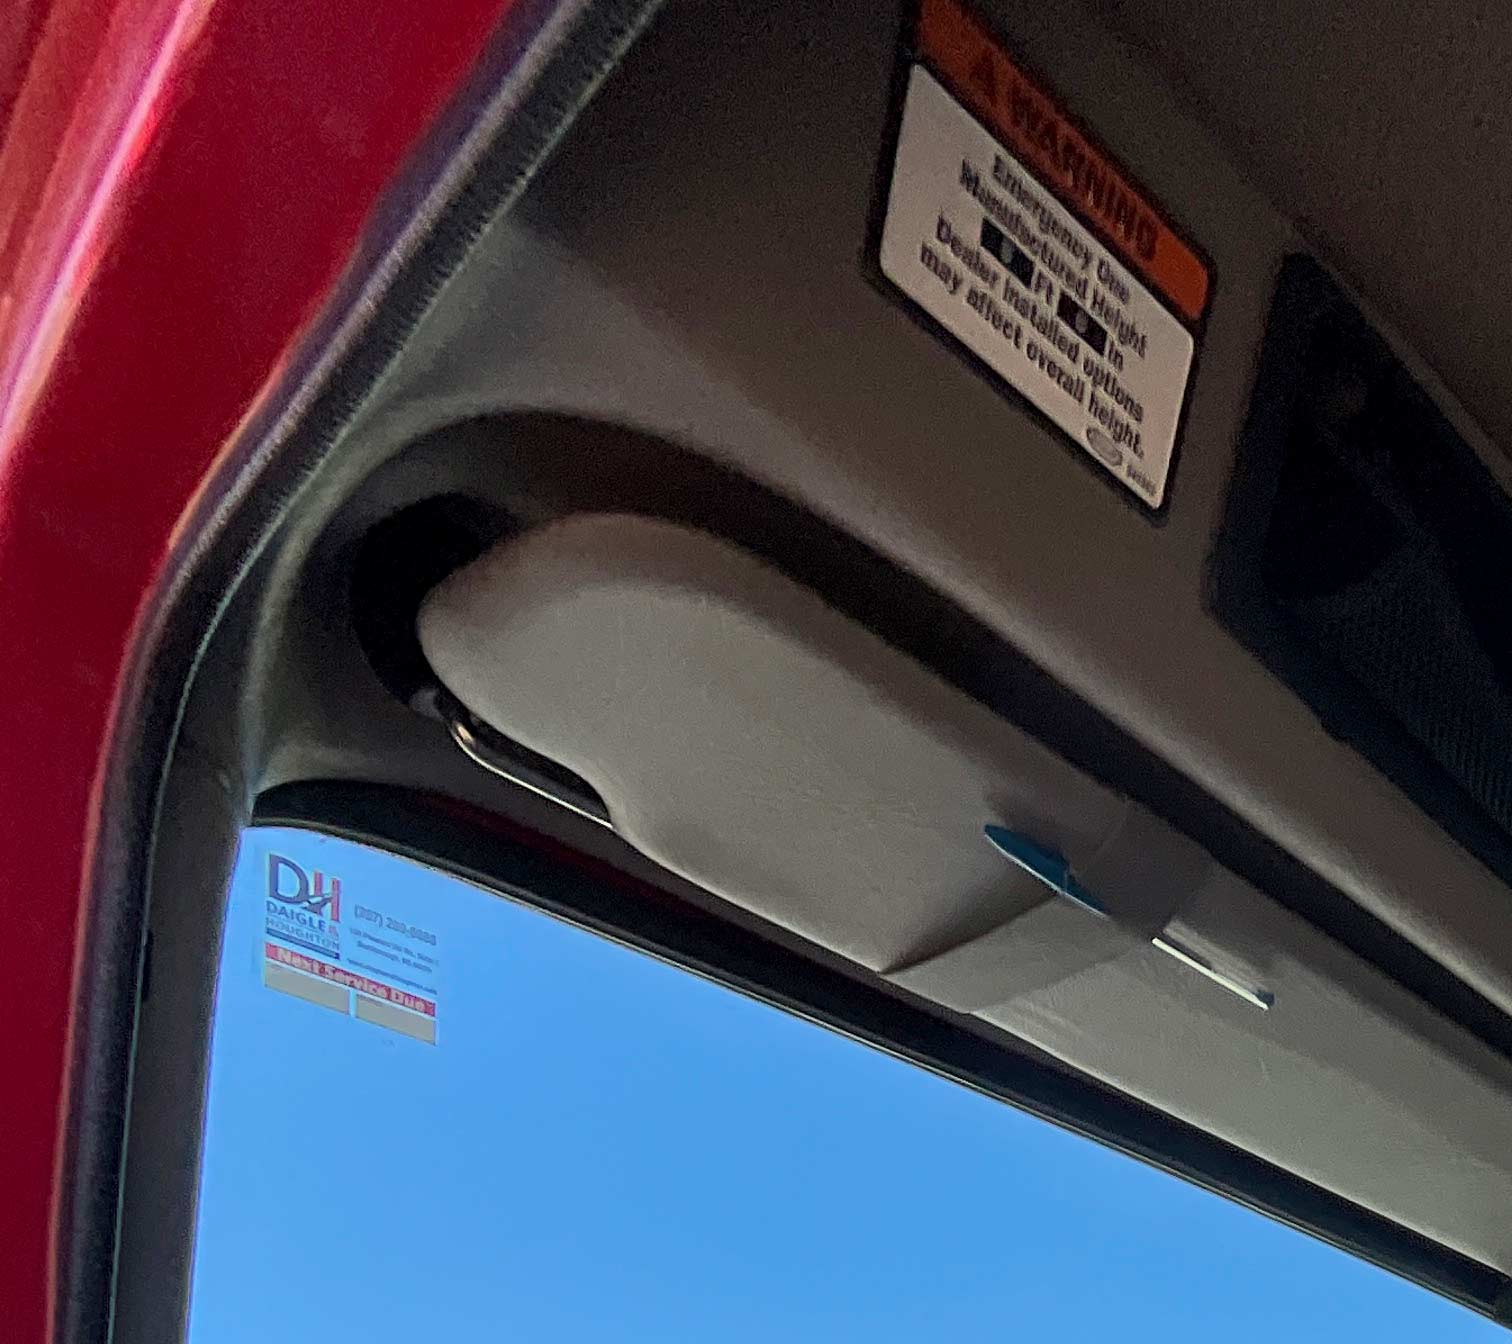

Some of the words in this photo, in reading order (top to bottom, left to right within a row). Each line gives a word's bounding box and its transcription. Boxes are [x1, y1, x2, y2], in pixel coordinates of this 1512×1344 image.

[959, 157, 1089, 301] Manufactured
[1091, 281, 1148, 360] Height
[993, 153, 1091, 270] Emergency
[1097, 256, 1131, 305] One
[920, 240, 963, 295] may
[966, 287, 1022, 350] affect
[1026, 340, 1085, 405] overall
[935, 212, 1000, 289] Dealer
[1083, 354, 1144, 424] options
[265, 900, 326, 933] DAIGLE
[323, 965, 390, 999] Service
[391, 988, 426, 1012] Due
